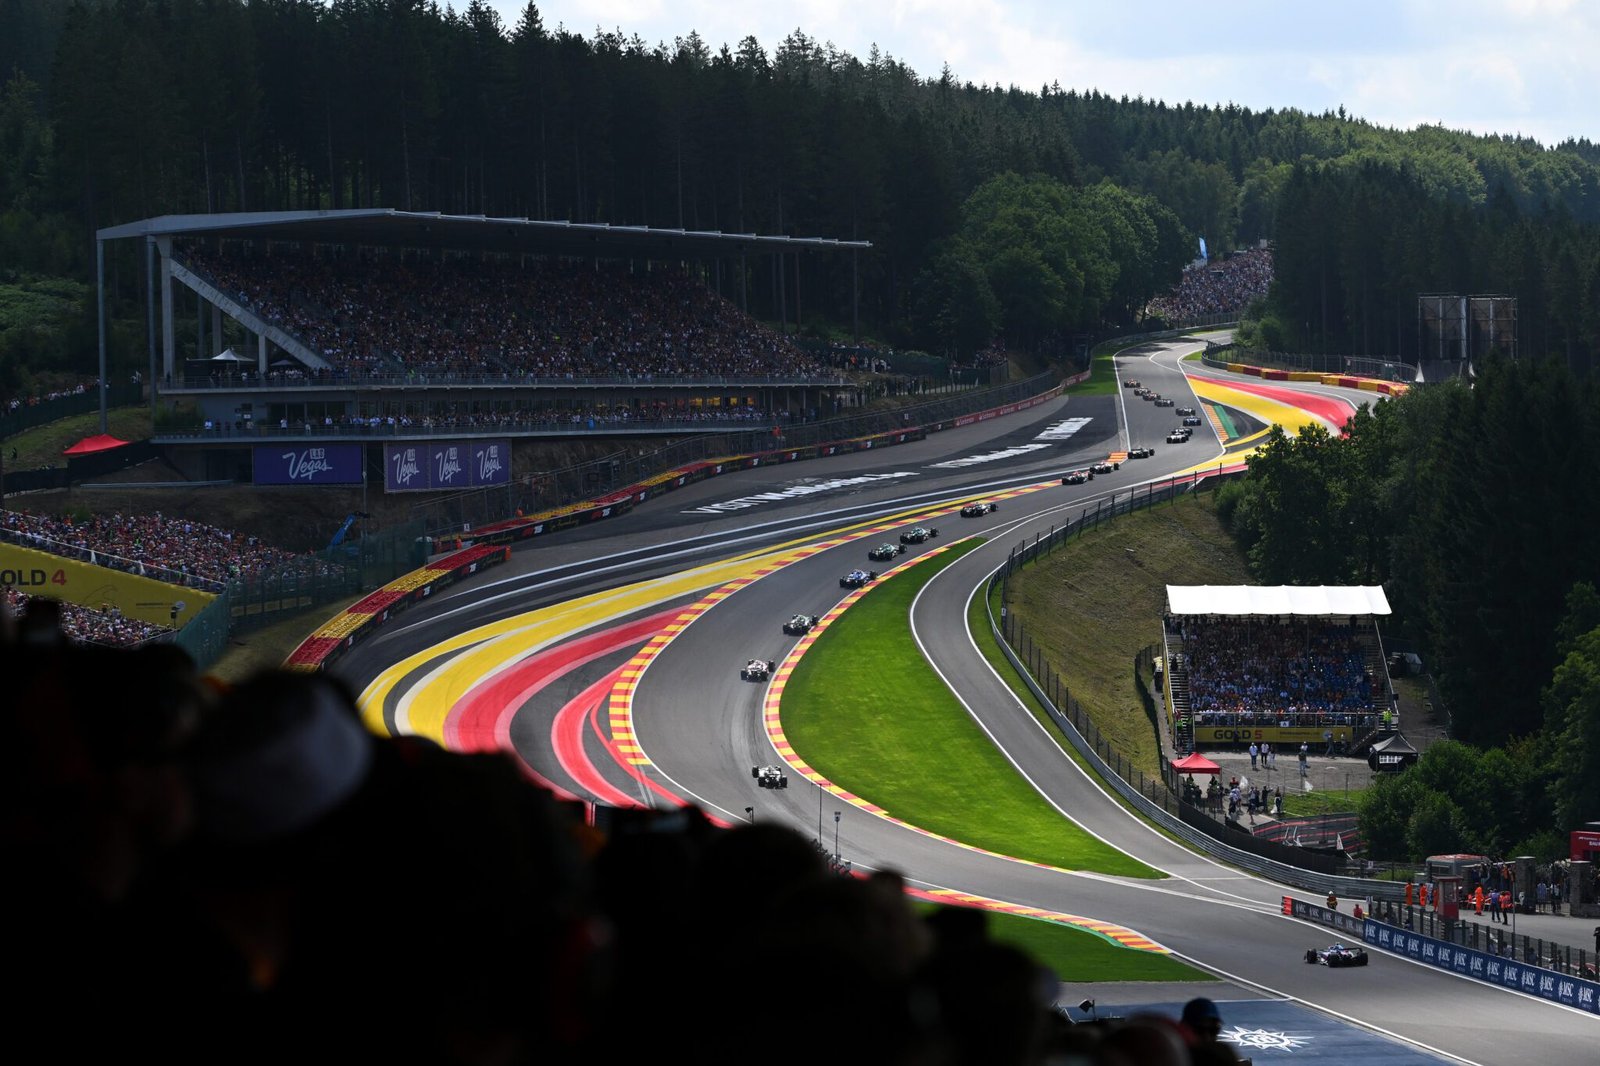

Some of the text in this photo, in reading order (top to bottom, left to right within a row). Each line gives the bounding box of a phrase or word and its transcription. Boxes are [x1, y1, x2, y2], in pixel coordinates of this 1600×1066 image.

[282, 450, 334, 481] Vegas
[393, 453, 420, 486] Vegas
[435, 451, 462, 485] Vegas
[476, 450, 502, 481] Vegas
[51, 569, 67, 586] 4
[1254, 729, 1263, 740] 5
